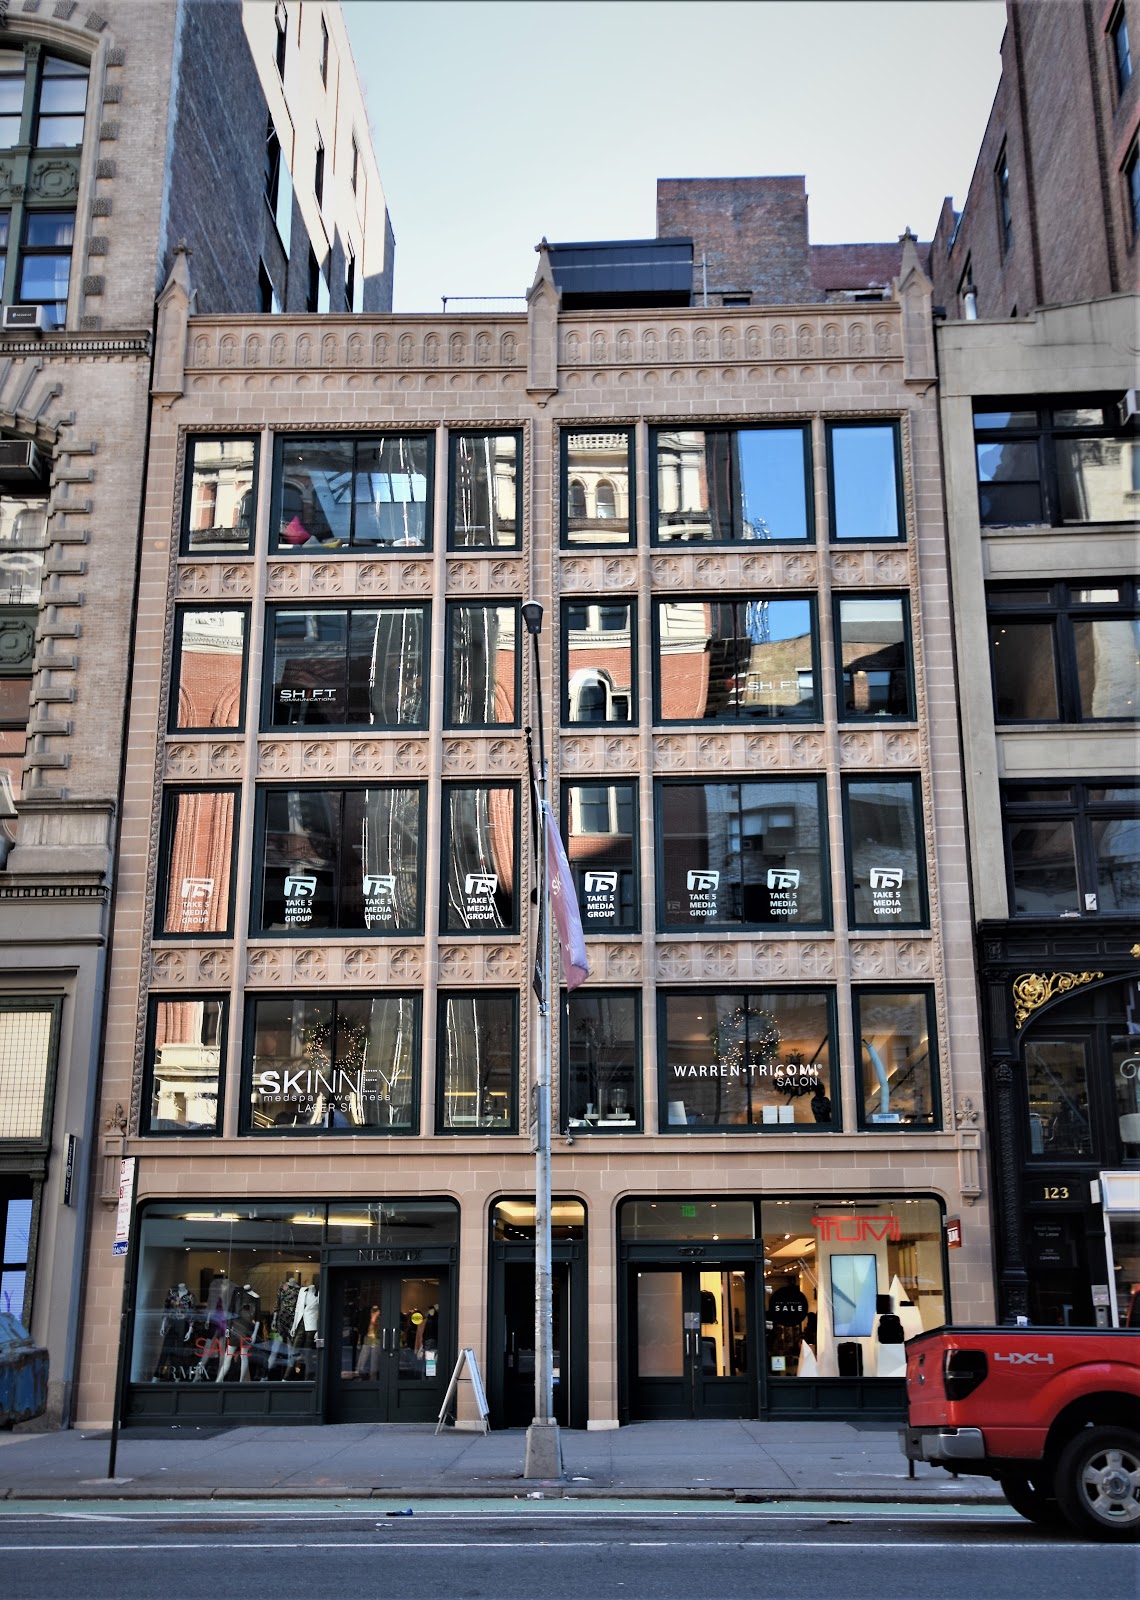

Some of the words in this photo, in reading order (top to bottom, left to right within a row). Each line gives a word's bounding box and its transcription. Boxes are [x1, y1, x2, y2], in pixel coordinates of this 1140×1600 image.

[747, 681, 803, 690] SHIFT
[280, 688, 337, 698] SHIFT
[873, 907, 902, 915] GROUP
[258, 1069, 402, 1094] SKINNEY
[777, 1077, 818, 1087] SALON
[263, 1094, 314, 1104] medspa
[334, 1094, 391, 1102] weness
[297, 1103, 336, 1113] LASER
[1043, 1187, 1070, 1199] 123
[811, 1216, 900, 1241] TUMI
[194, 1337, 253, 1357] SALE
